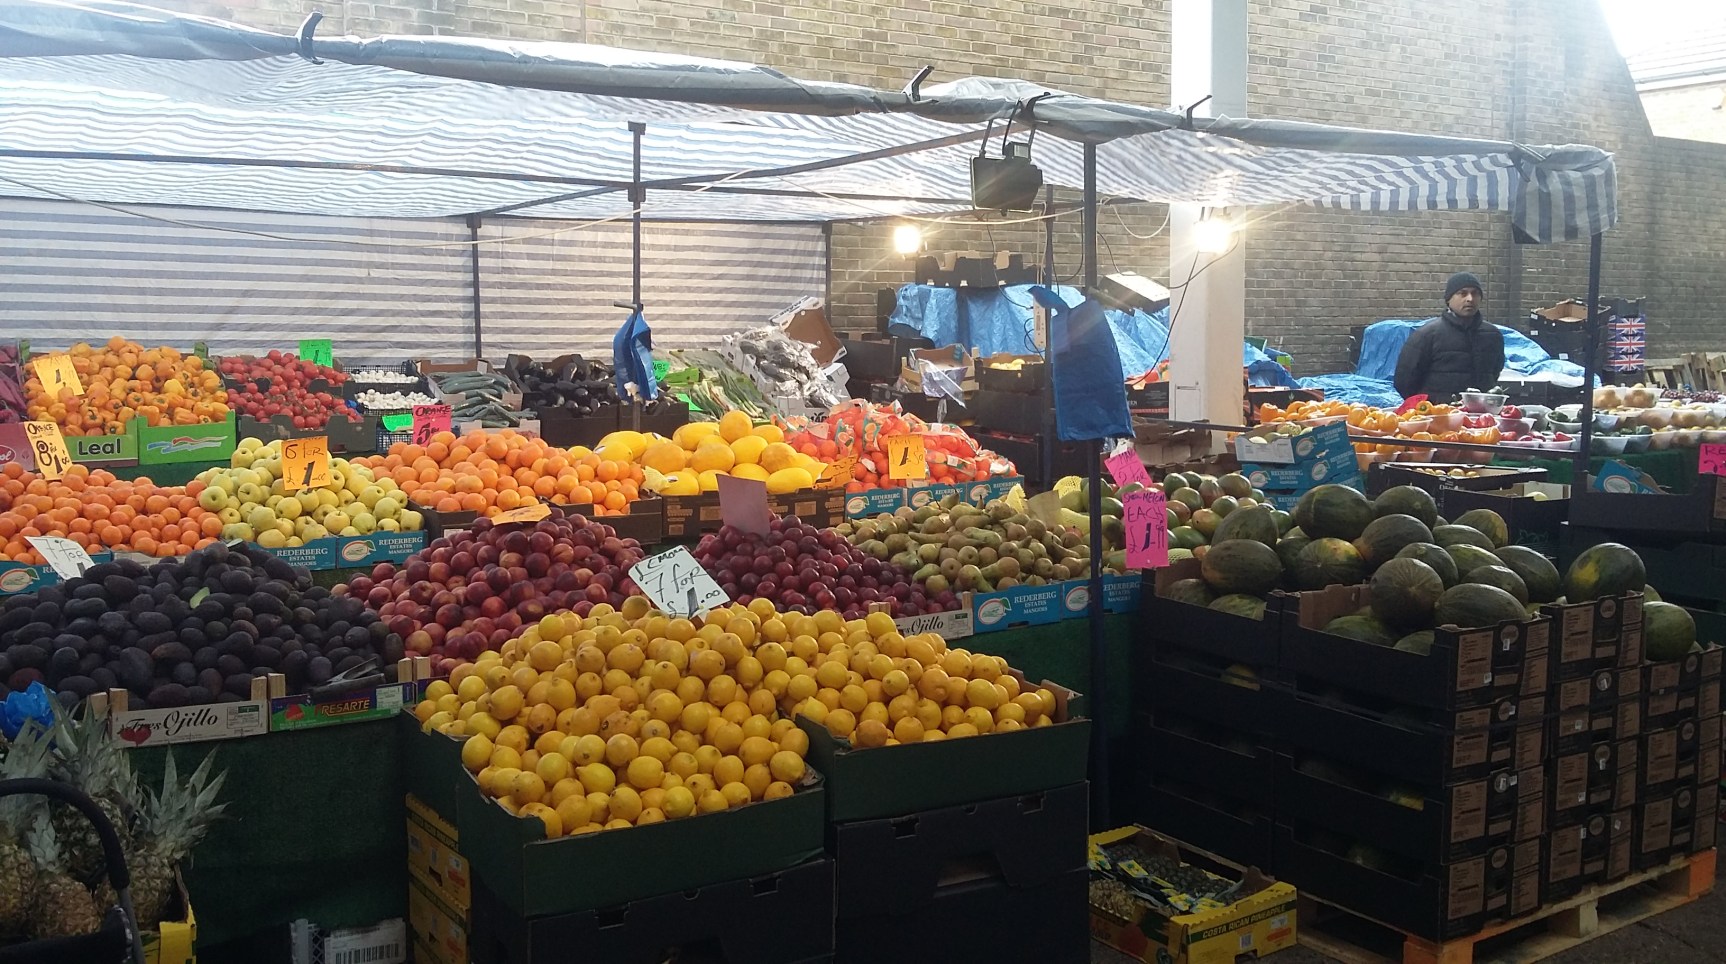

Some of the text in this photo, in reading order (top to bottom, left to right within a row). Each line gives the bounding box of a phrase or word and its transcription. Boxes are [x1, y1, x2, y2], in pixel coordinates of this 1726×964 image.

[78, 438, 121, 456] Leal
[379, 537, 423, 546] REDERBERG
[276, 548, 328, 557] REDERBERG
[644, 571, 665, 603] 7
[1014, 591, 1057, 604] REDERBERG
[1024, 600, 1047, 608] ESTATES
[1023, 606, 1048, 615] MANGOES
[911, 616, 944, 635] Ojillo
[163, 707, 218, 737] Ojillo
[1202, 904, 1286, 939] COSTA RICAN PINEAPPLE
